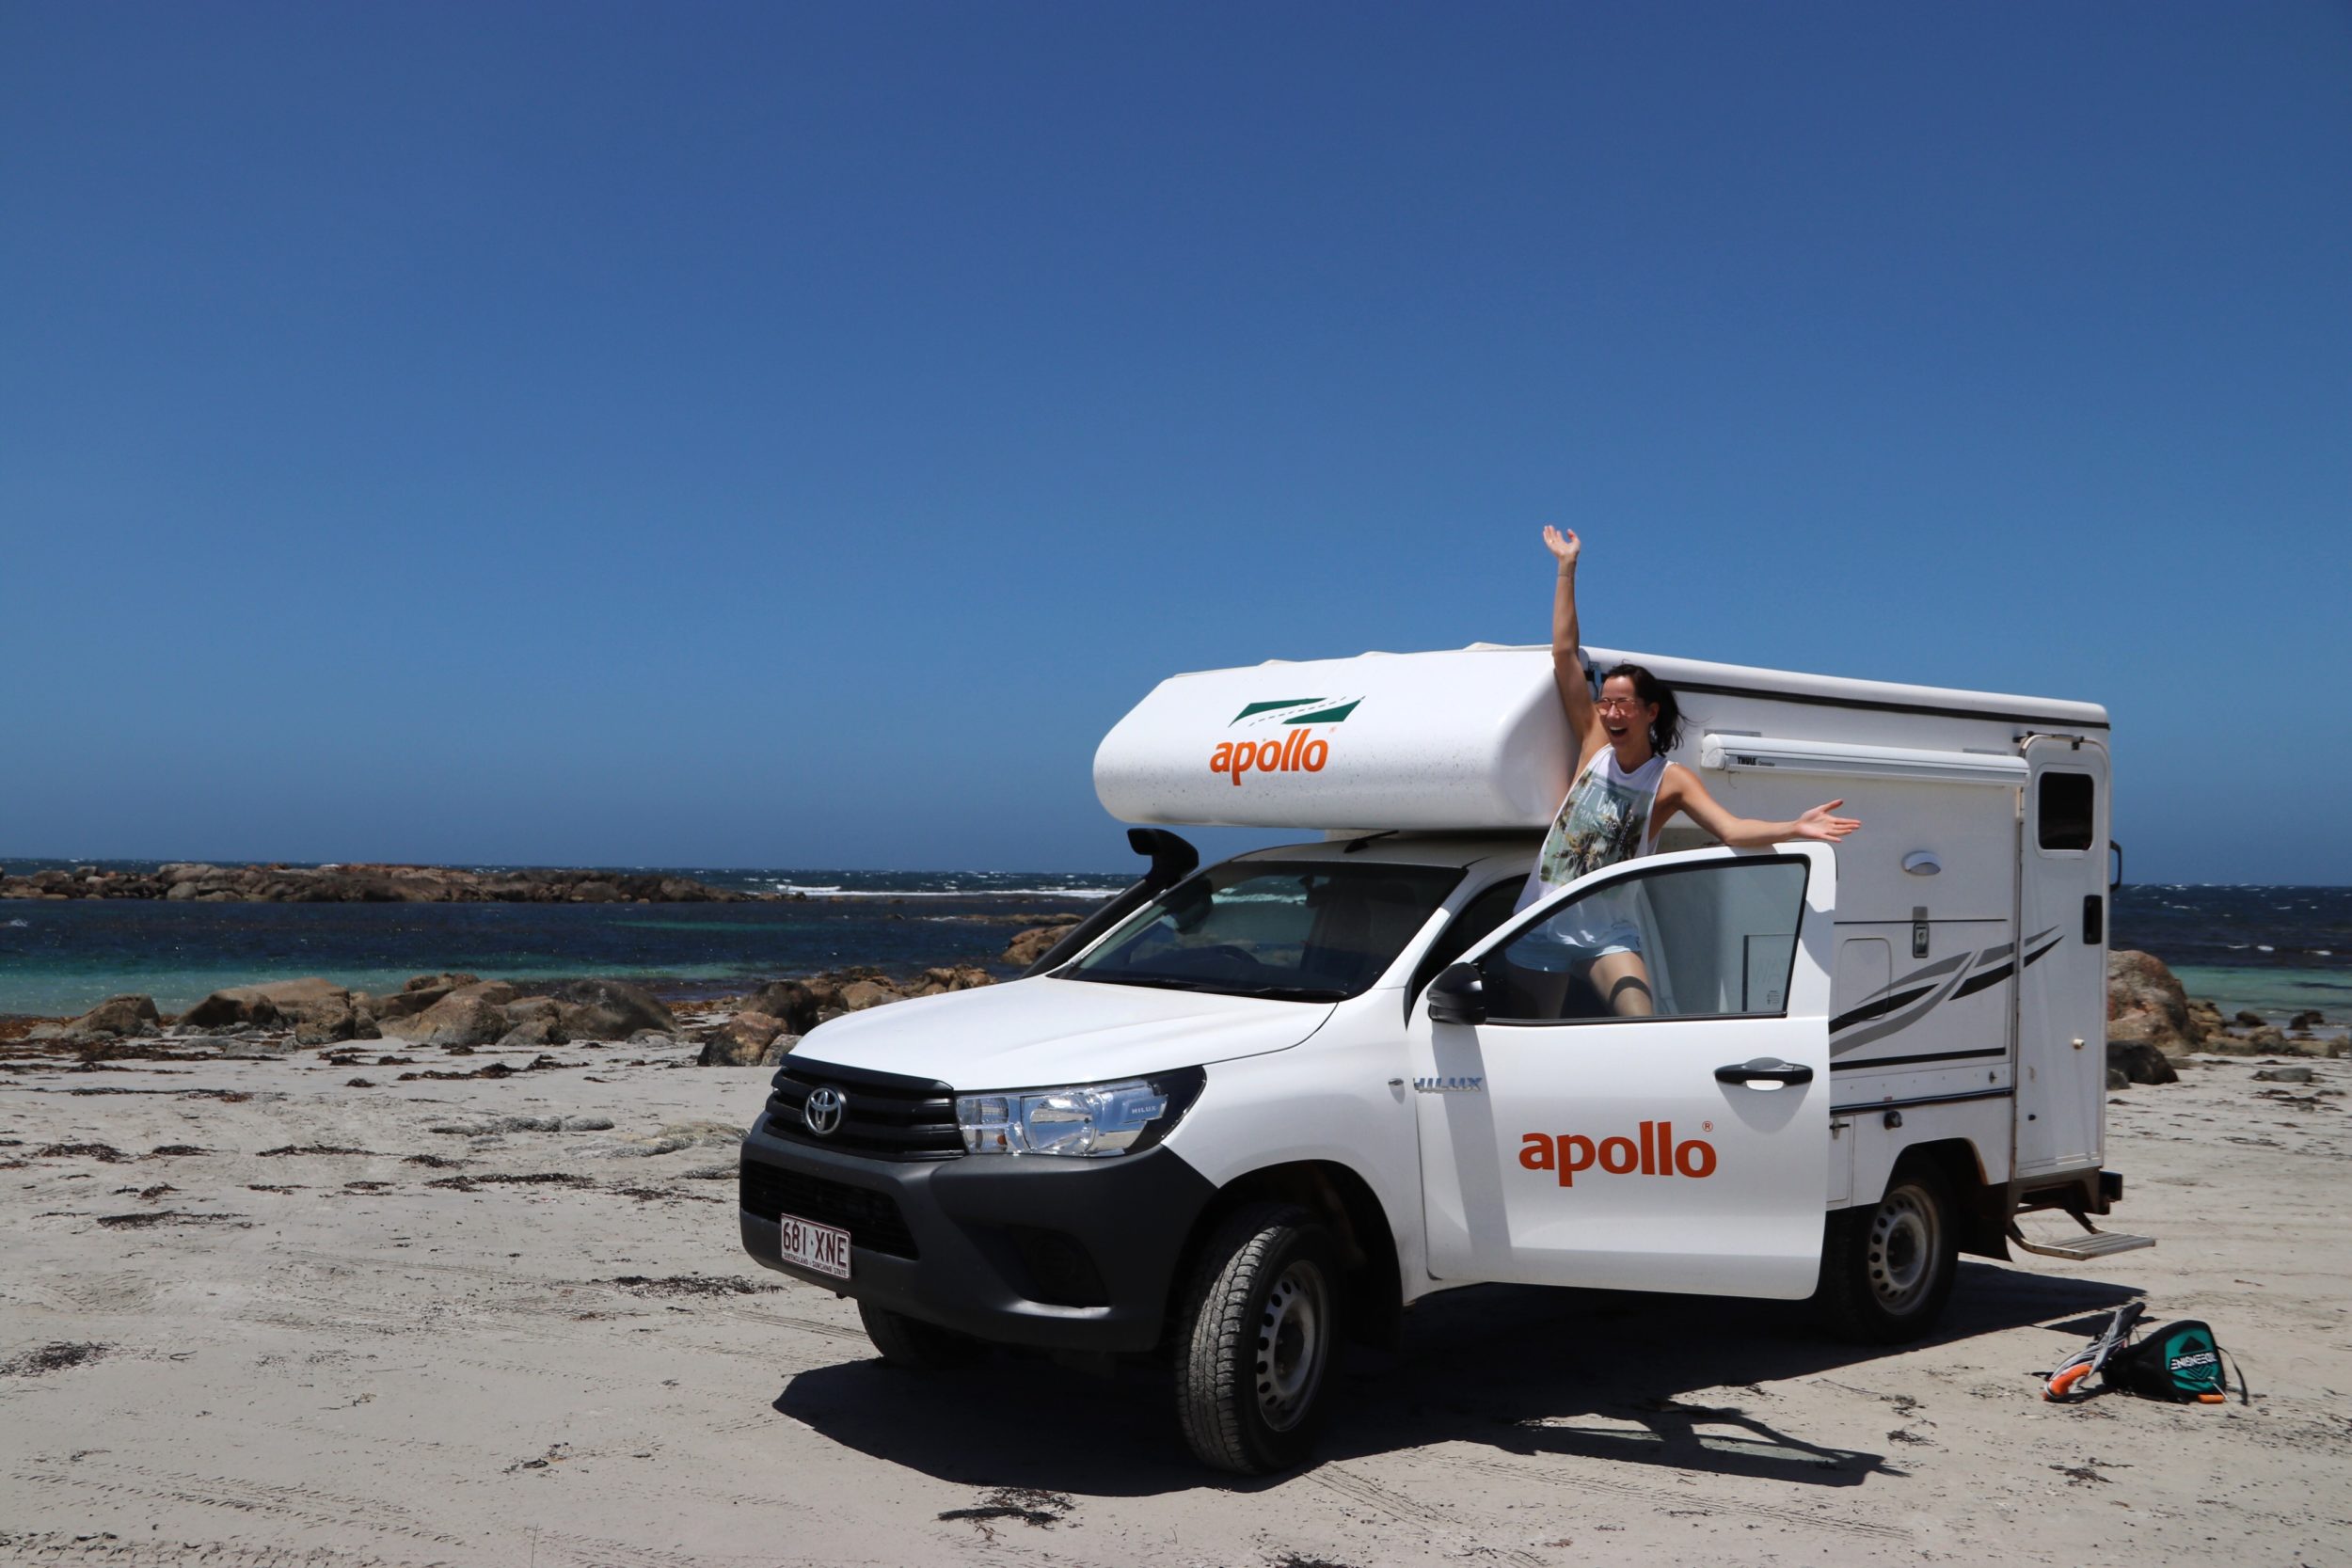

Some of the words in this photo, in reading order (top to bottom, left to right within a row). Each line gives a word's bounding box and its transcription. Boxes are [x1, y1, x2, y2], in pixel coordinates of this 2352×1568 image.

[1210, 728, 1328, 786] apollo
[1581, 786, 1596, 806] I
[1413, 1077, 1483, 1093] HILUX
[1132, 1105, 1157, 1114] HILUX
[1518, 1120, 1717, 1187] apollo
[783, 1221, 806, 1256] 681
[815, 1229, 847, 1268] XNE
